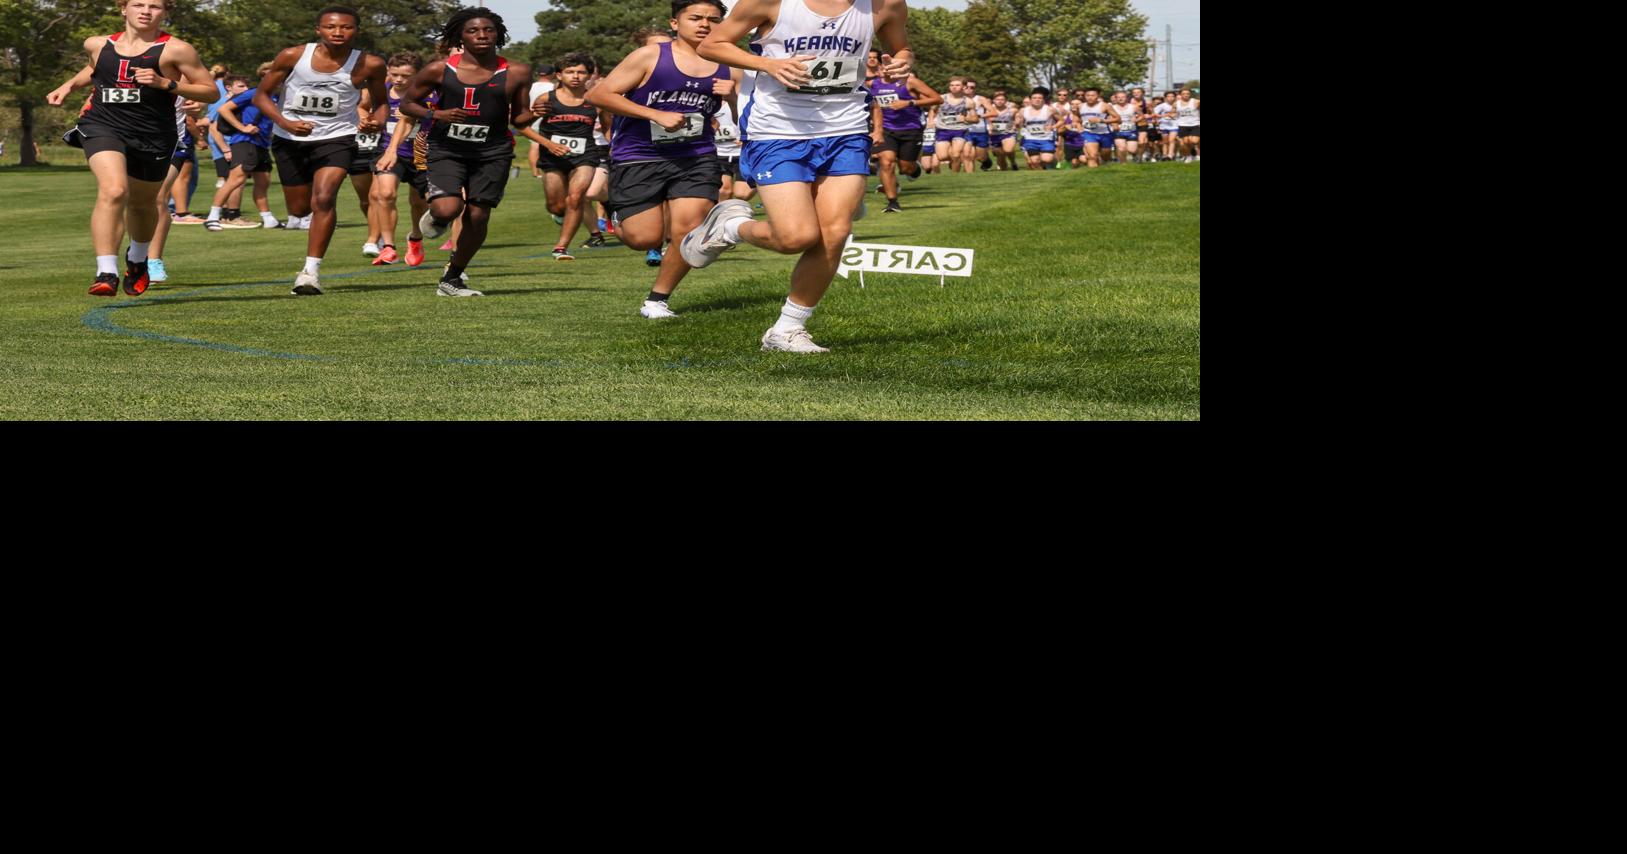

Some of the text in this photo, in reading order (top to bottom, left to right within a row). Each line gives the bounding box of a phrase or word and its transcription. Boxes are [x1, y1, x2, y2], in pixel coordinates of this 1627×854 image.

[784, 36, 862, 54] KEARNEY
[117, 59, 134, 82] L
[811, 61, 843, 80] 61
[102, 89, 140, 102] 135
[301, 95, 333, 108] 118
[463, 87, 480, 109] L
[646, 90, 717, 114] ISLANDERS
[879, 95, 895, 105] 157
[682, 116, 693, 131] 4
[359, 133, 377, 143] 99
[452, 125, 487, 139] 146
